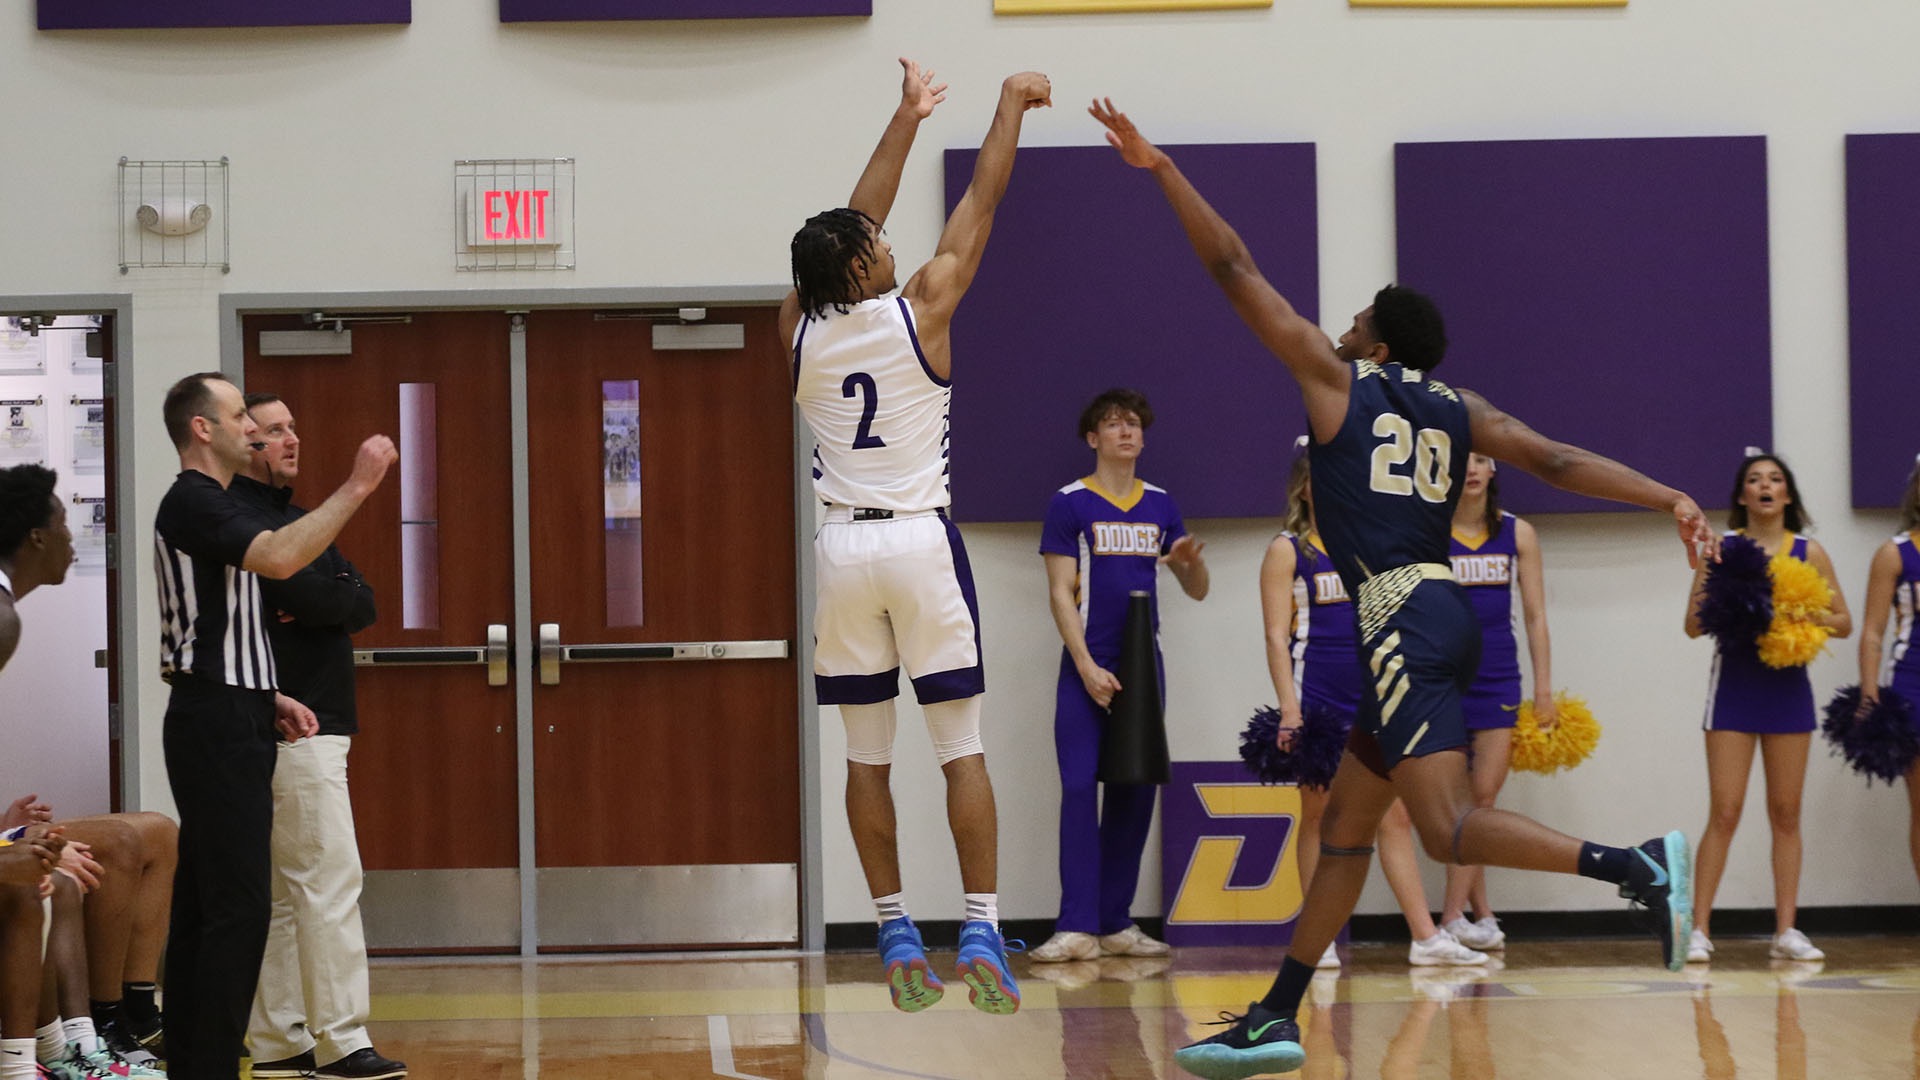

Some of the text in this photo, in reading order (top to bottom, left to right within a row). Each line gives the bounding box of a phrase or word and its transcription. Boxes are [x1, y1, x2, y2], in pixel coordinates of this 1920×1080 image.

[484, 190, 549, 240] EXIT
[842, 372, 887, 450] 2
[1370, 412, 1453, 504] 20
[1093, 522, 1160, 556] DODGE
[1167, 783, 1304, 925] D
